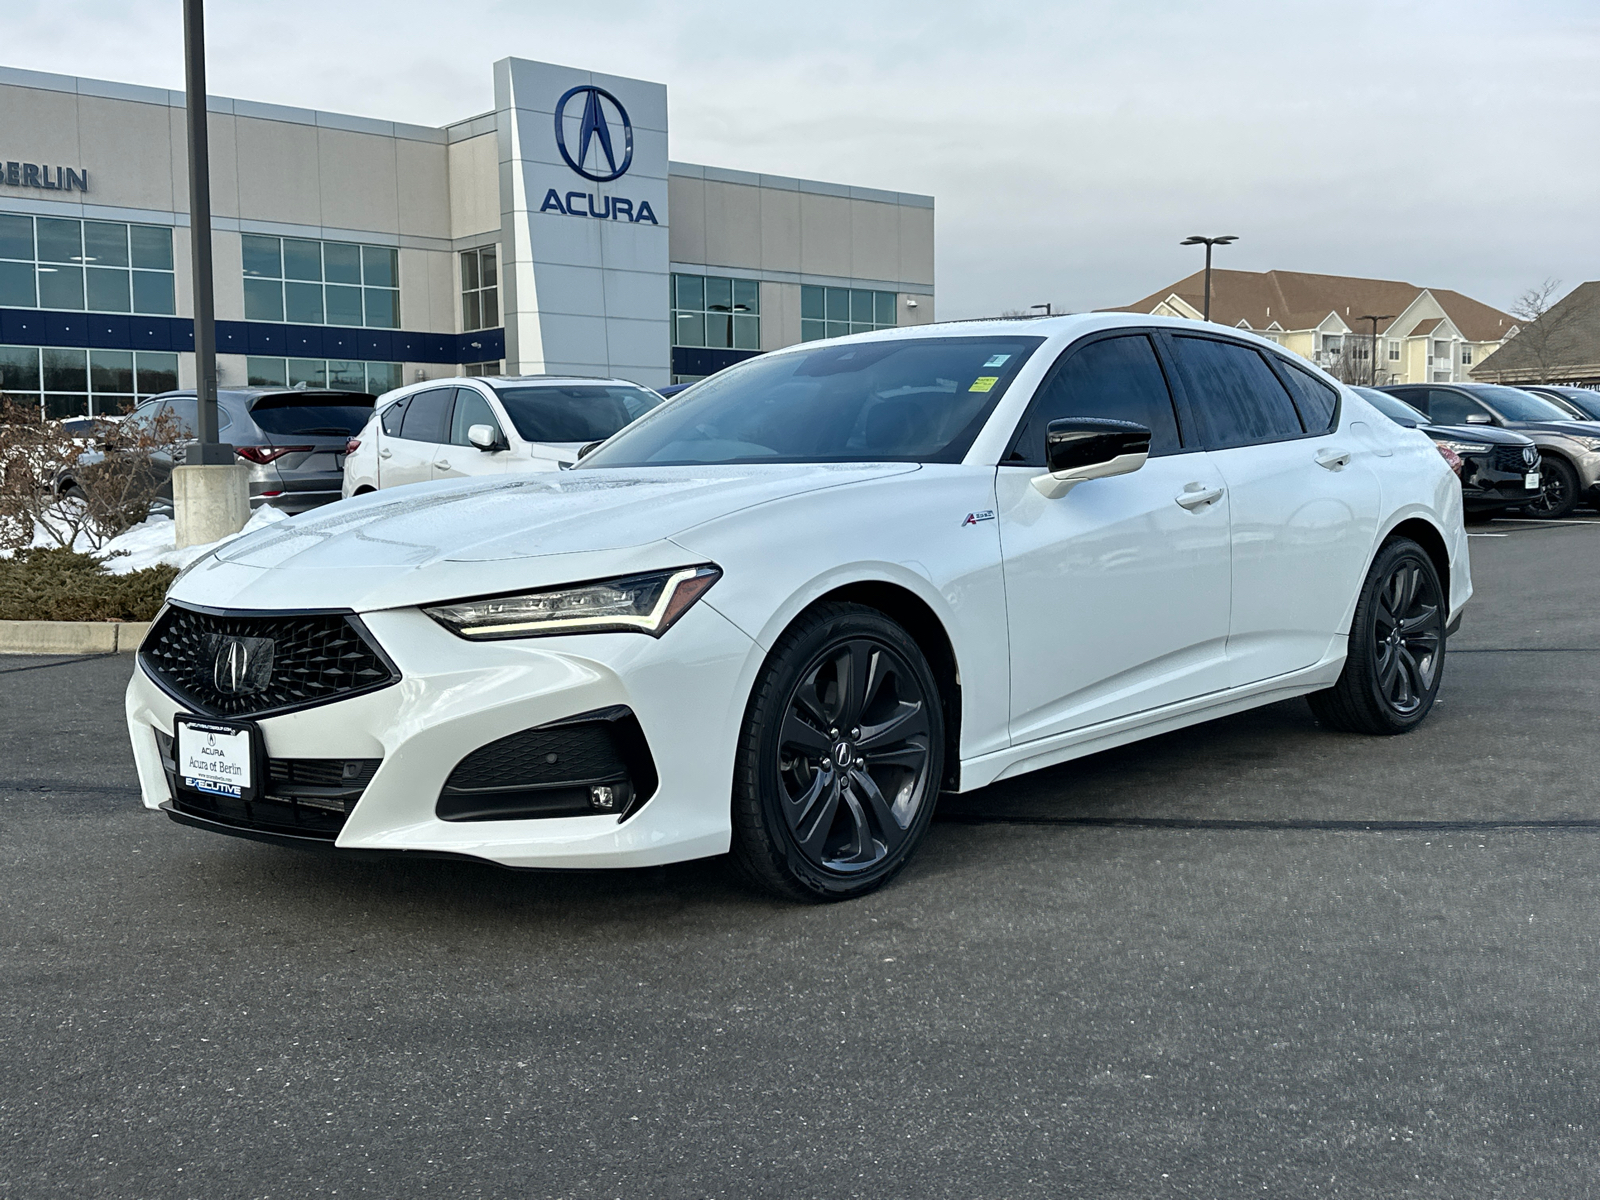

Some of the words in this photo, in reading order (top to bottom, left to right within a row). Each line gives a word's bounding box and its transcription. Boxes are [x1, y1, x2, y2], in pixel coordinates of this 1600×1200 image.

[539, 187, 659, 225] ACURA
[201, 747, 225, 757] ACURA
[189, 756, 209, 770] Acura
[209, 761, 217, 772] of
[219, 761, 242, 775] Berlin
[186, 777, 241, 795] EXECUTIVE
